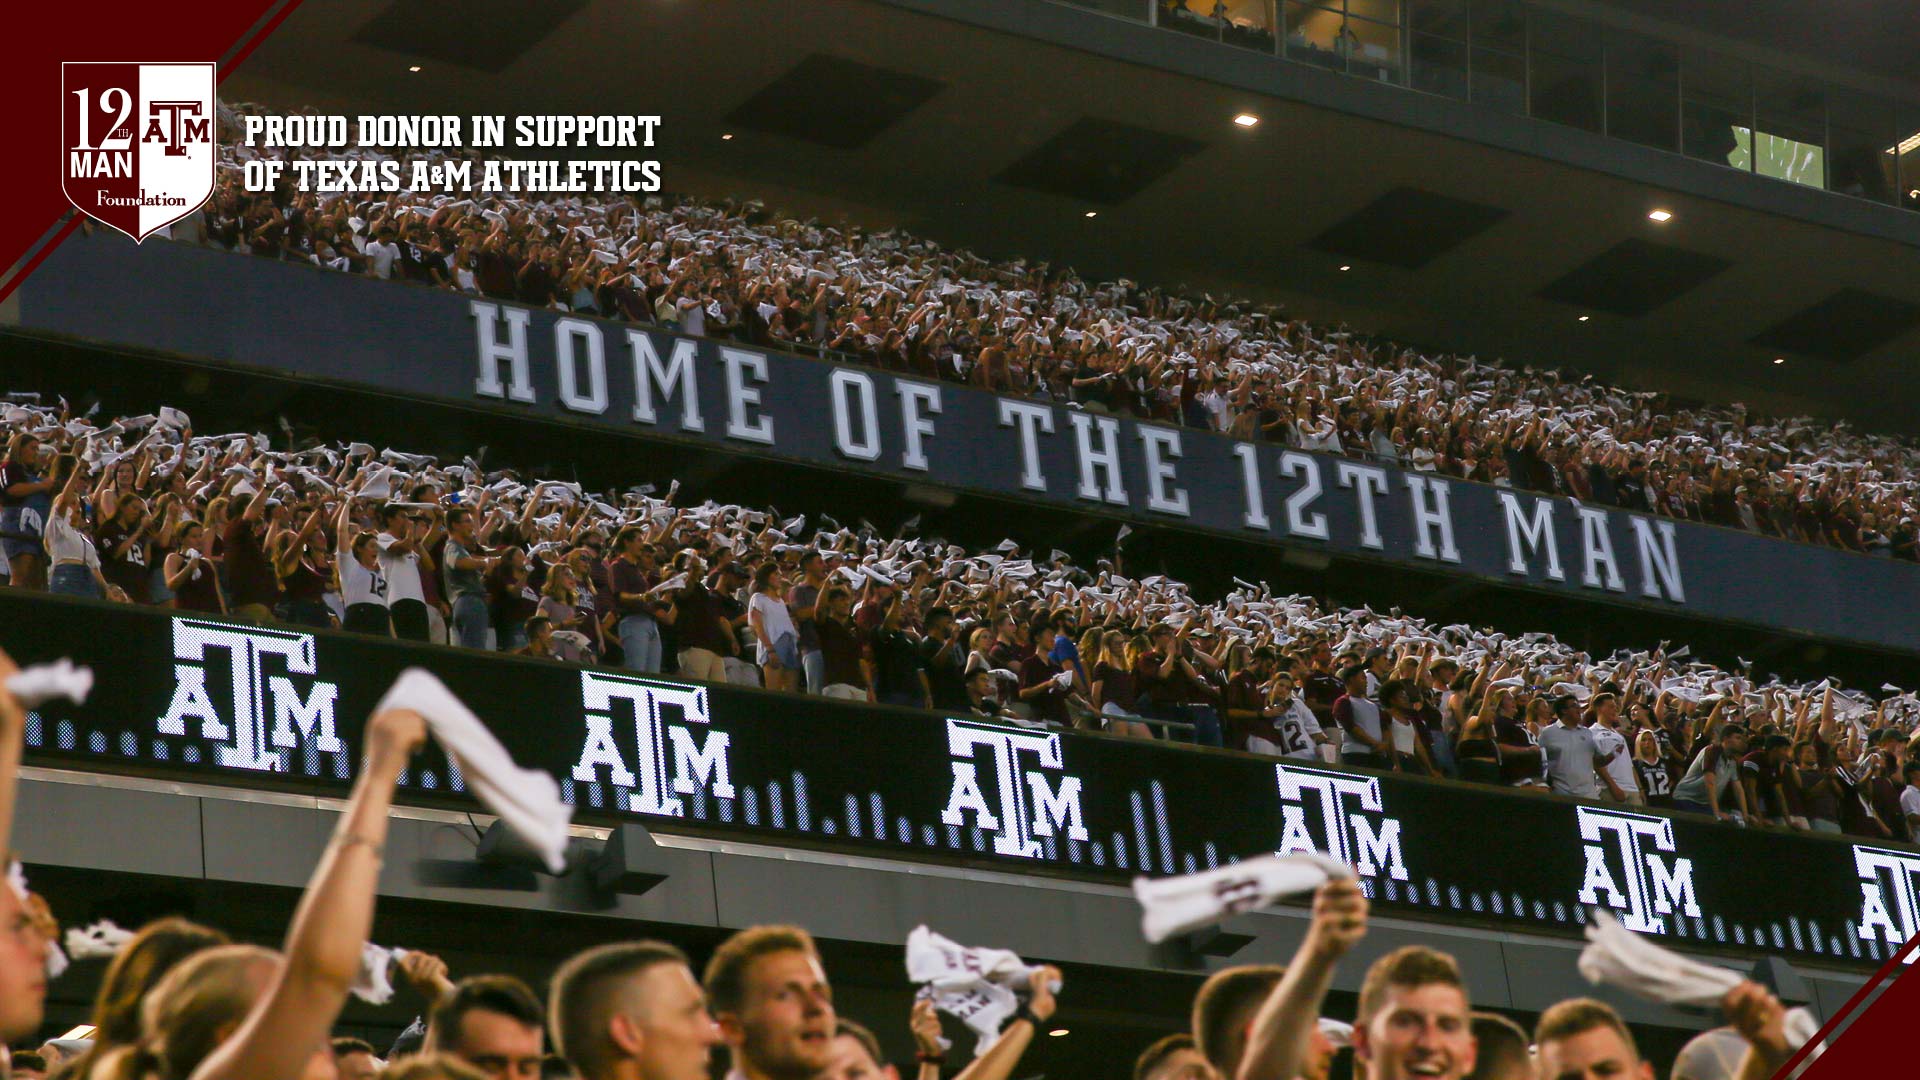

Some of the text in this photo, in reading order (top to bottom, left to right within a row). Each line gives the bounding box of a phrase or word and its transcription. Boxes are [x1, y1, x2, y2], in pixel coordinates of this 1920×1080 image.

[470, 300, 1685, 602] HOME OF THE 12TH MAN
[370, 572, 388, 598] 12
[1644, 772, 1670, 796] 12
